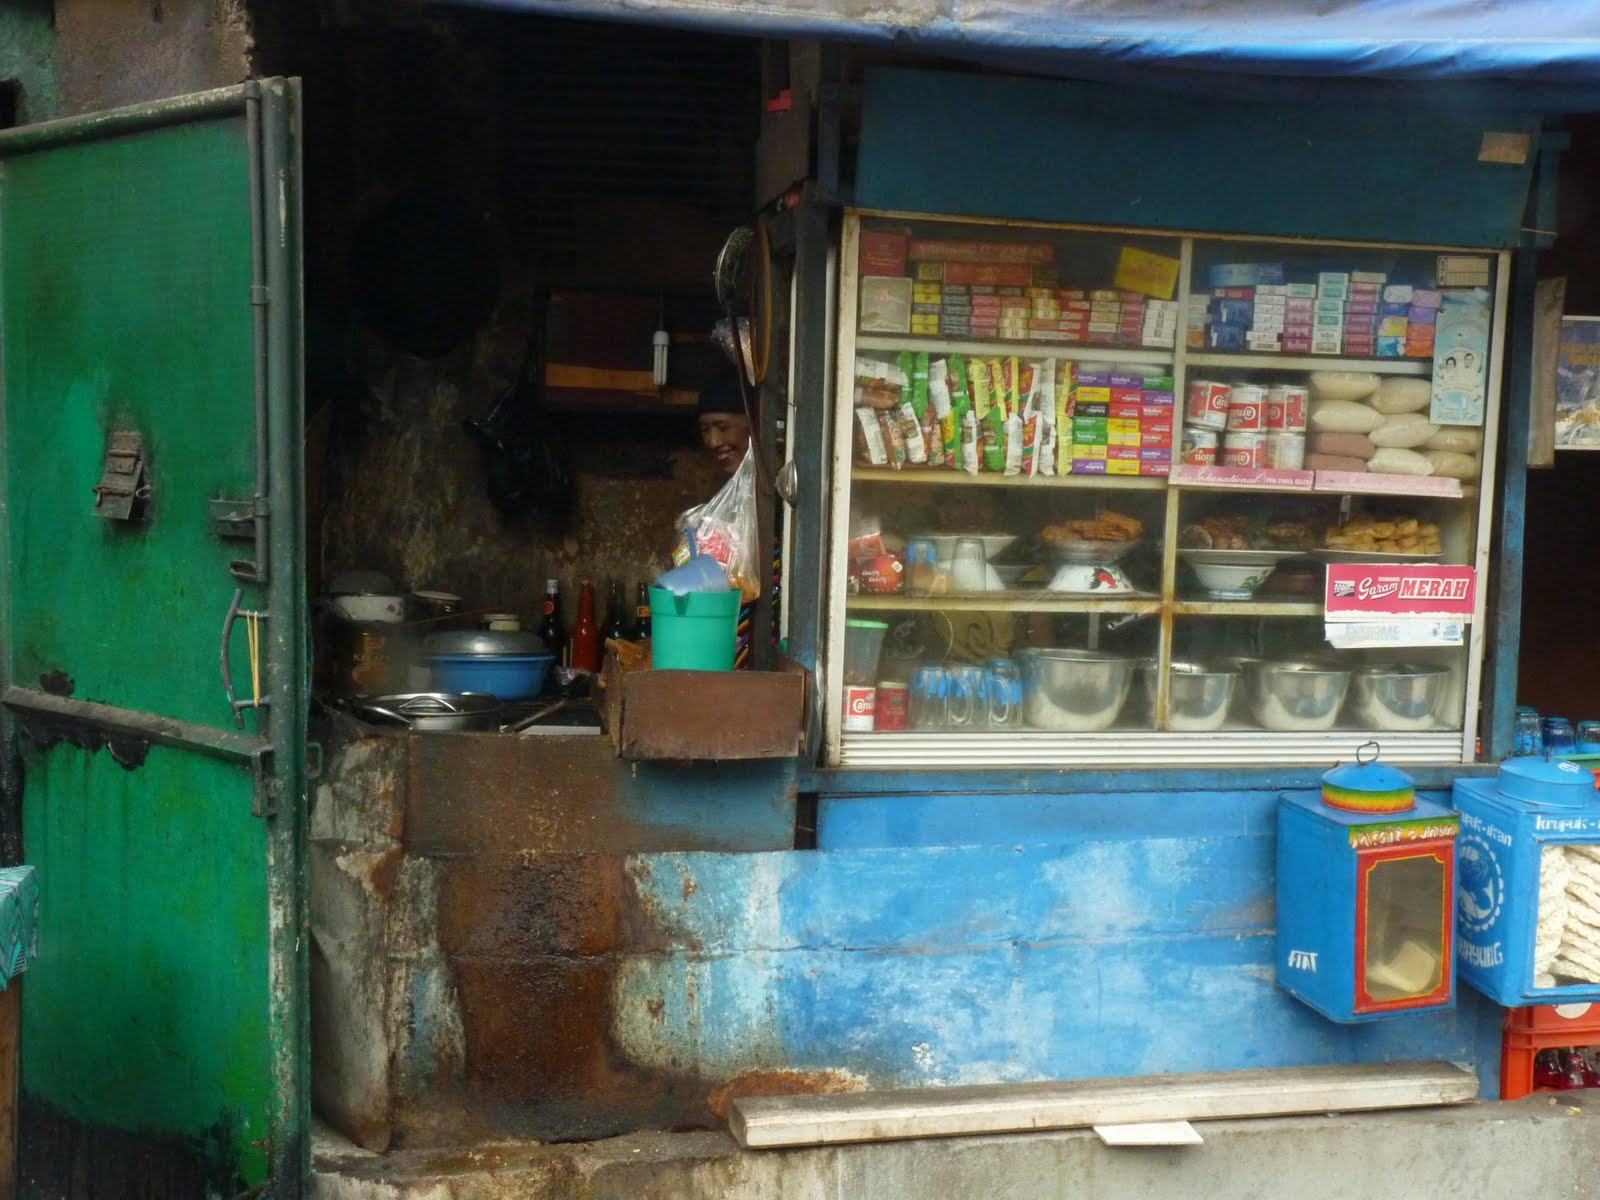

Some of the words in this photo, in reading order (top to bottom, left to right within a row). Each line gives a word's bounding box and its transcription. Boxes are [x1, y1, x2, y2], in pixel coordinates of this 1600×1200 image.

[1358, 577, 1399, 600] Garam
[1398, 577, 1470, 600] MERAH
[1288, 950, 1319, 972] FIAT
